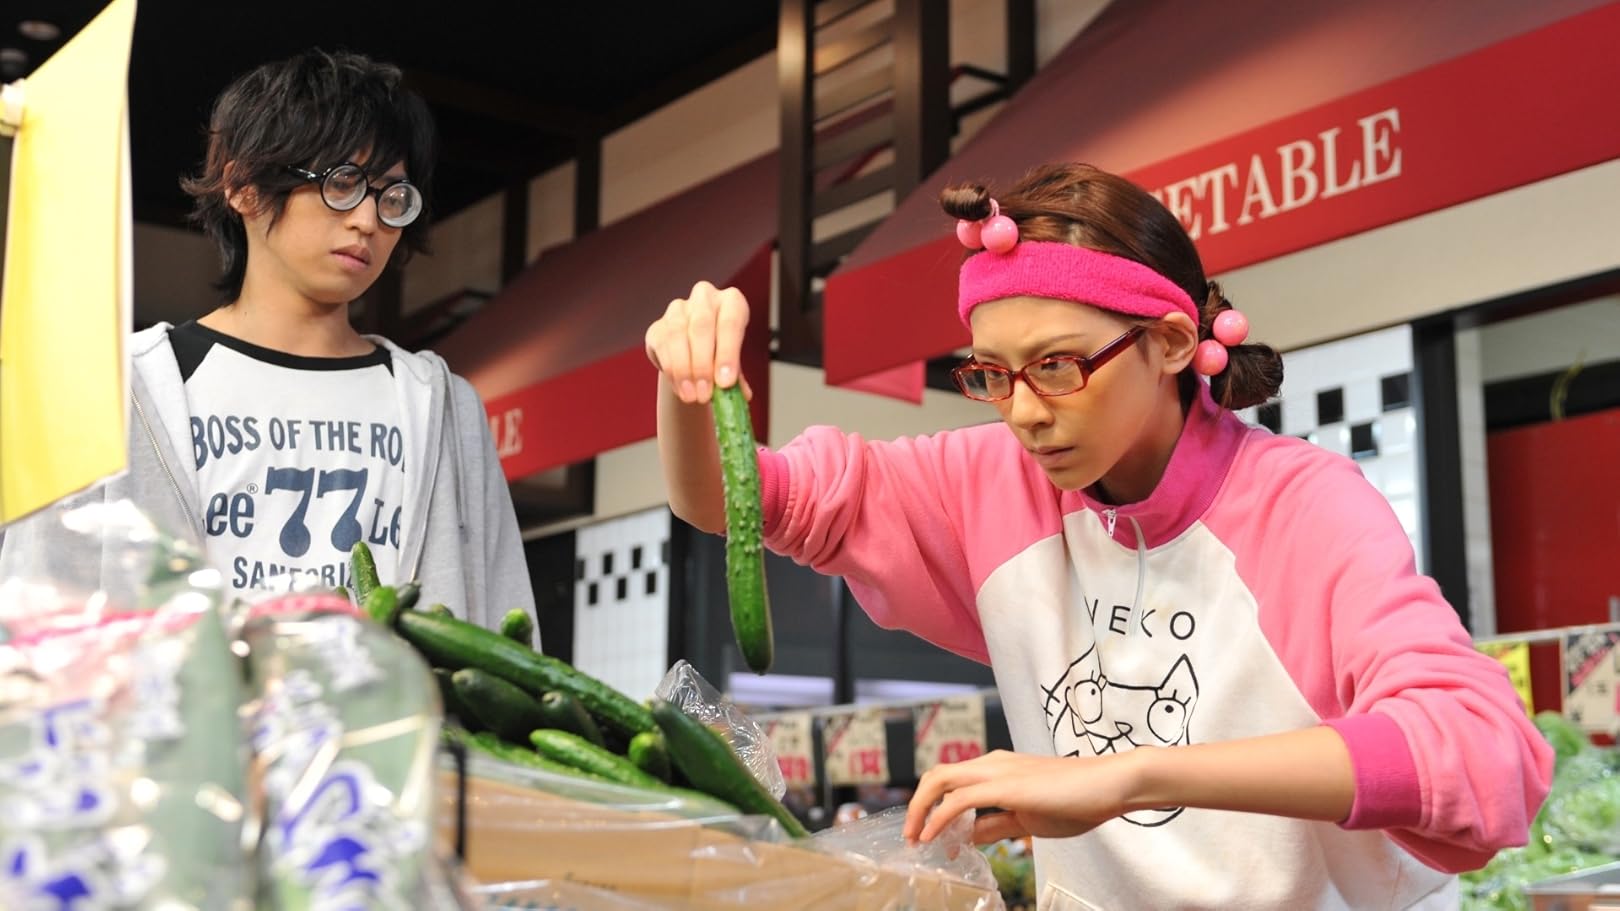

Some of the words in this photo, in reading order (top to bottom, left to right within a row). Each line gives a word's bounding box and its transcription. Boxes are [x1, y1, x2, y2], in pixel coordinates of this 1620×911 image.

[1148, 107, 1402, 241] ETABLE
[190, 414, 262, 471] BOSS
[269, 417, 302, 451] OF
[308, 420, 362, 454] THE
[370, 422, 405, 473] RO
[202, 491, 255, 538] ee
[265, 467, 368, 558] 77
